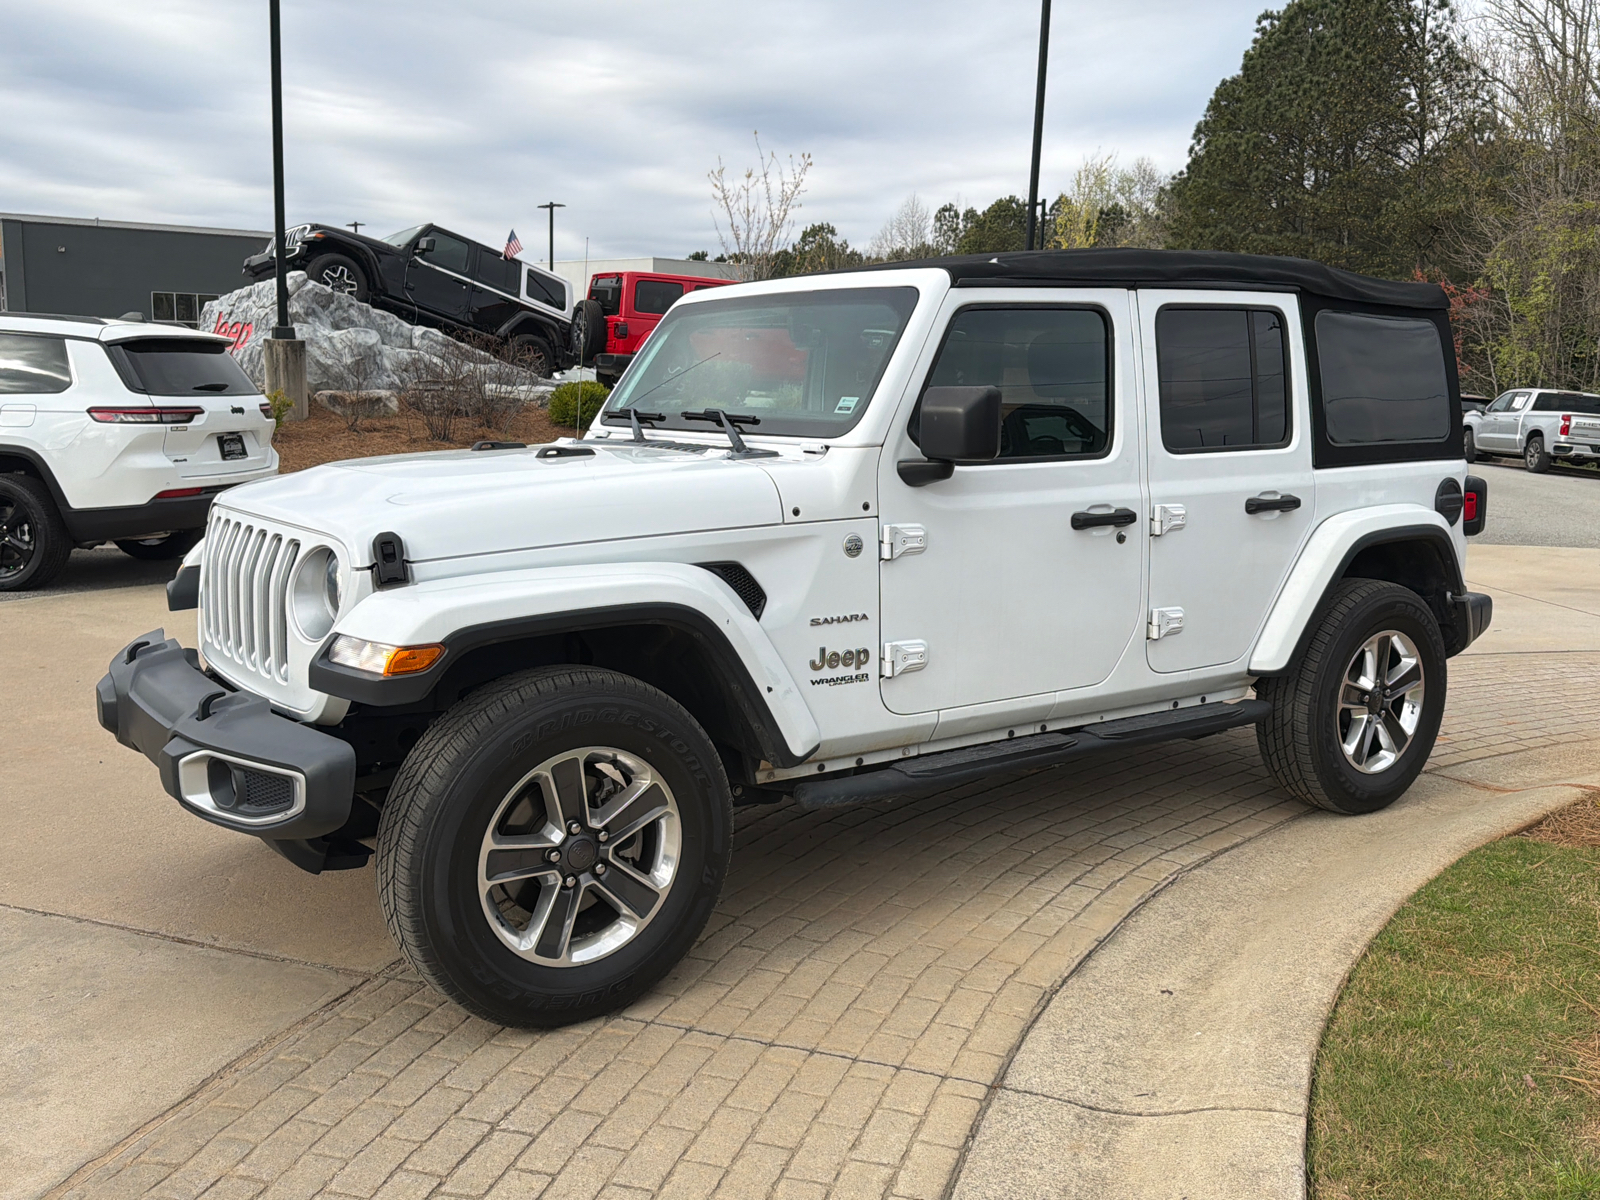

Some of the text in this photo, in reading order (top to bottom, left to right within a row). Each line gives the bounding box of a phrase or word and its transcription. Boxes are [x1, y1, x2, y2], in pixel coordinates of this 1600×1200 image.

[810, 612, 869, 626] SAHARA
[809, 646, 870, 671] Jeep
[810, 673, 869, 686] WRANGLER
[828, 678, 869, 687] UNLIMITED
[510, 706, 712, 790] BRIDGESTONE
